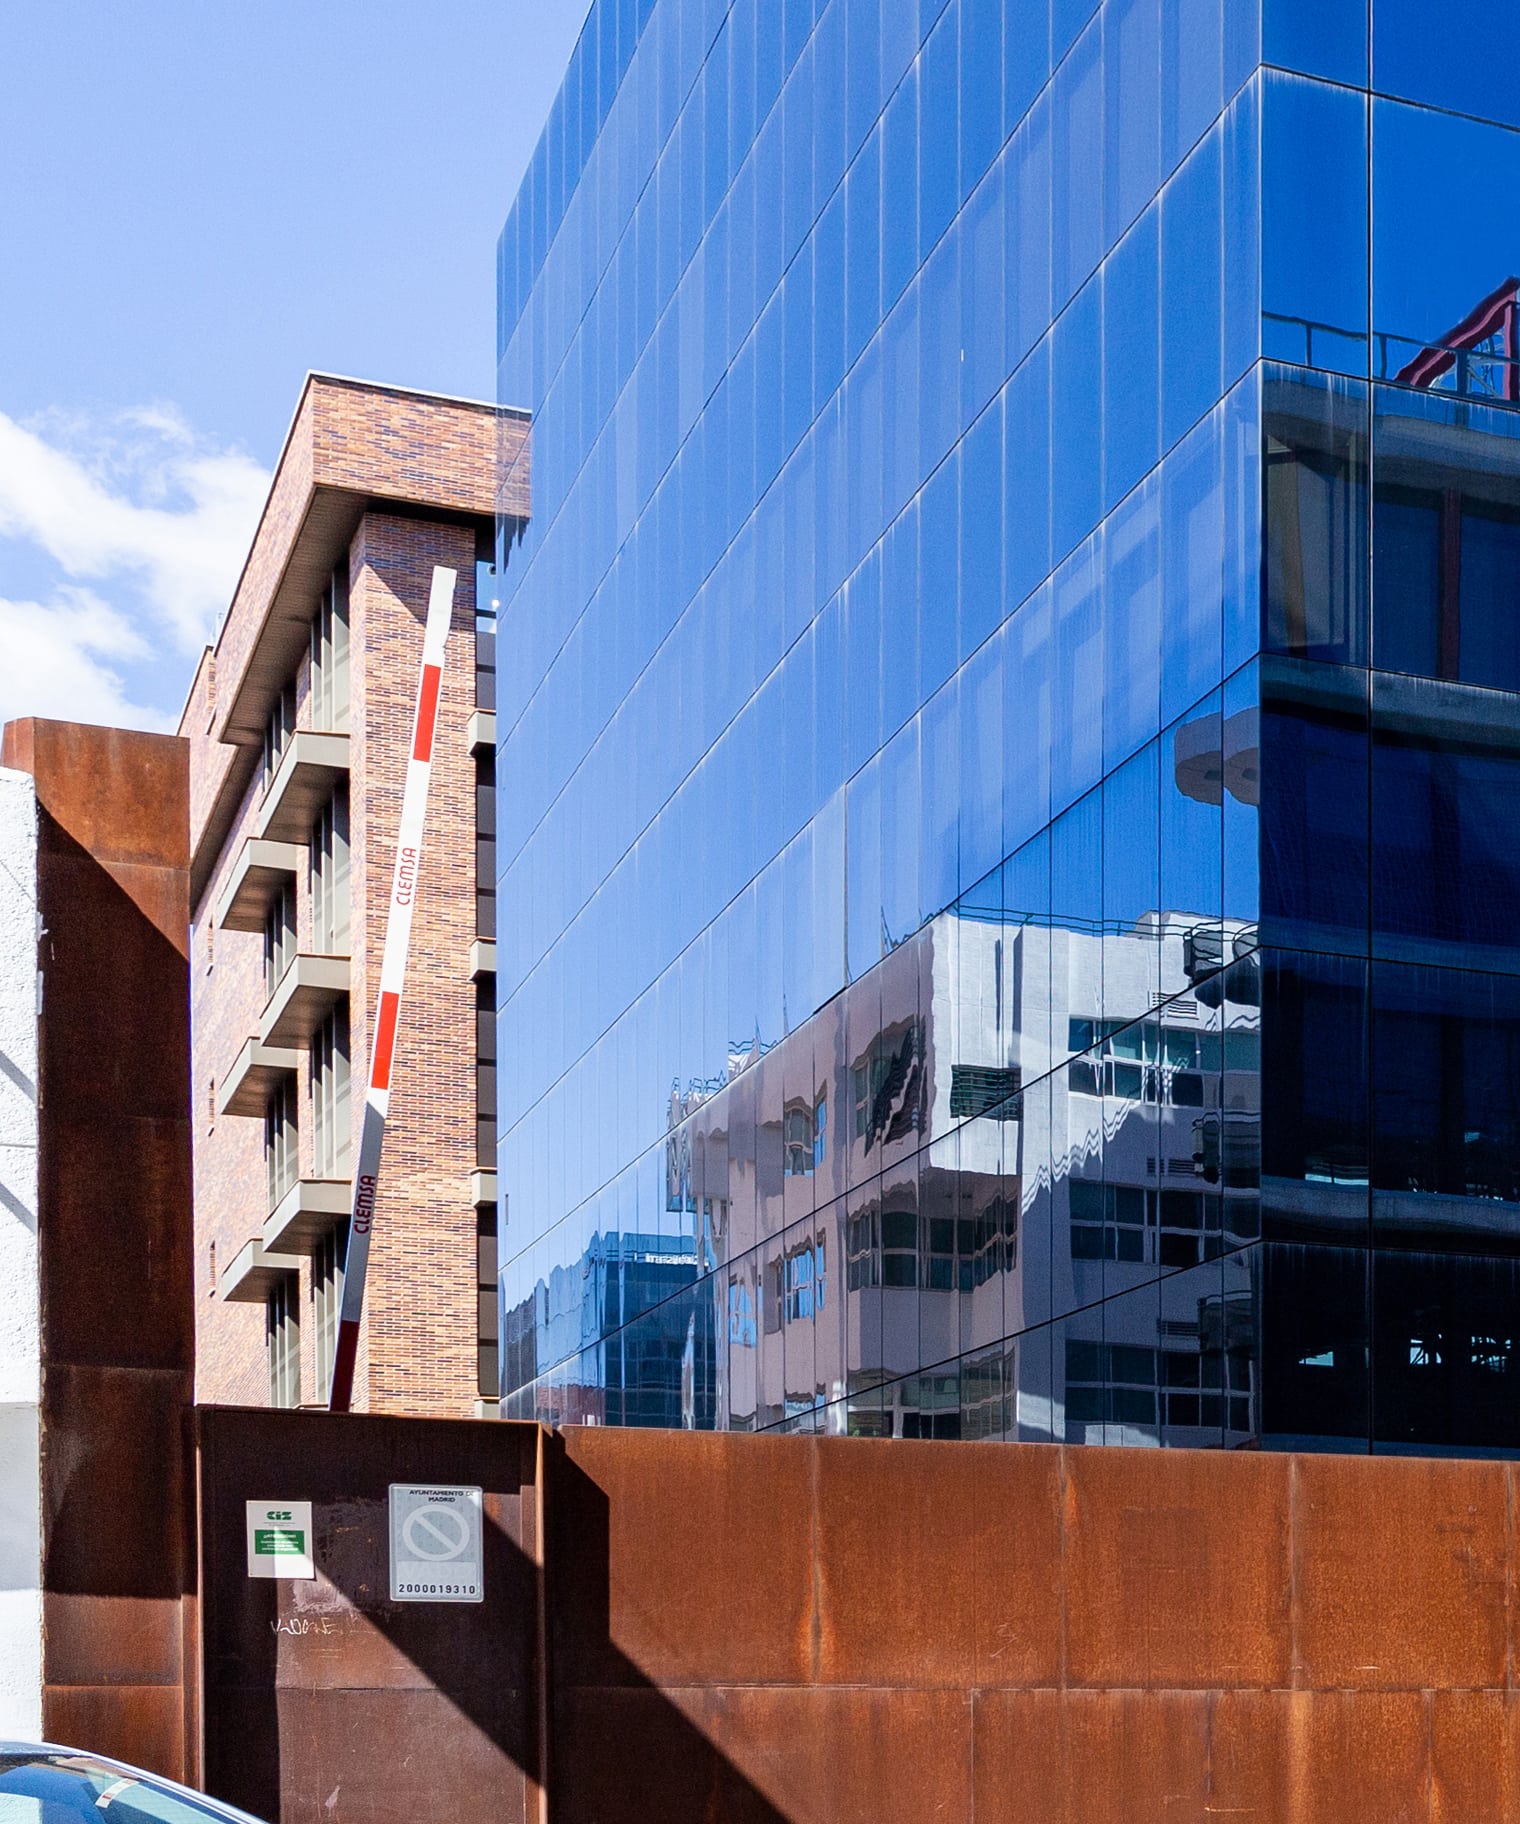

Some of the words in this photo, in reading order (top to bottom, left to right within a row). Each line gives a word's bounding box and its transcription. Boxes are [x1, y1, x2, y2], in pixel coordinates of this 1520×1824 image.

[396, 847, 417, 906] CLEMSA
[354, 1174, 376, 1235] CLEMSA
[398, 1583, 476, 1595] 2000019310
